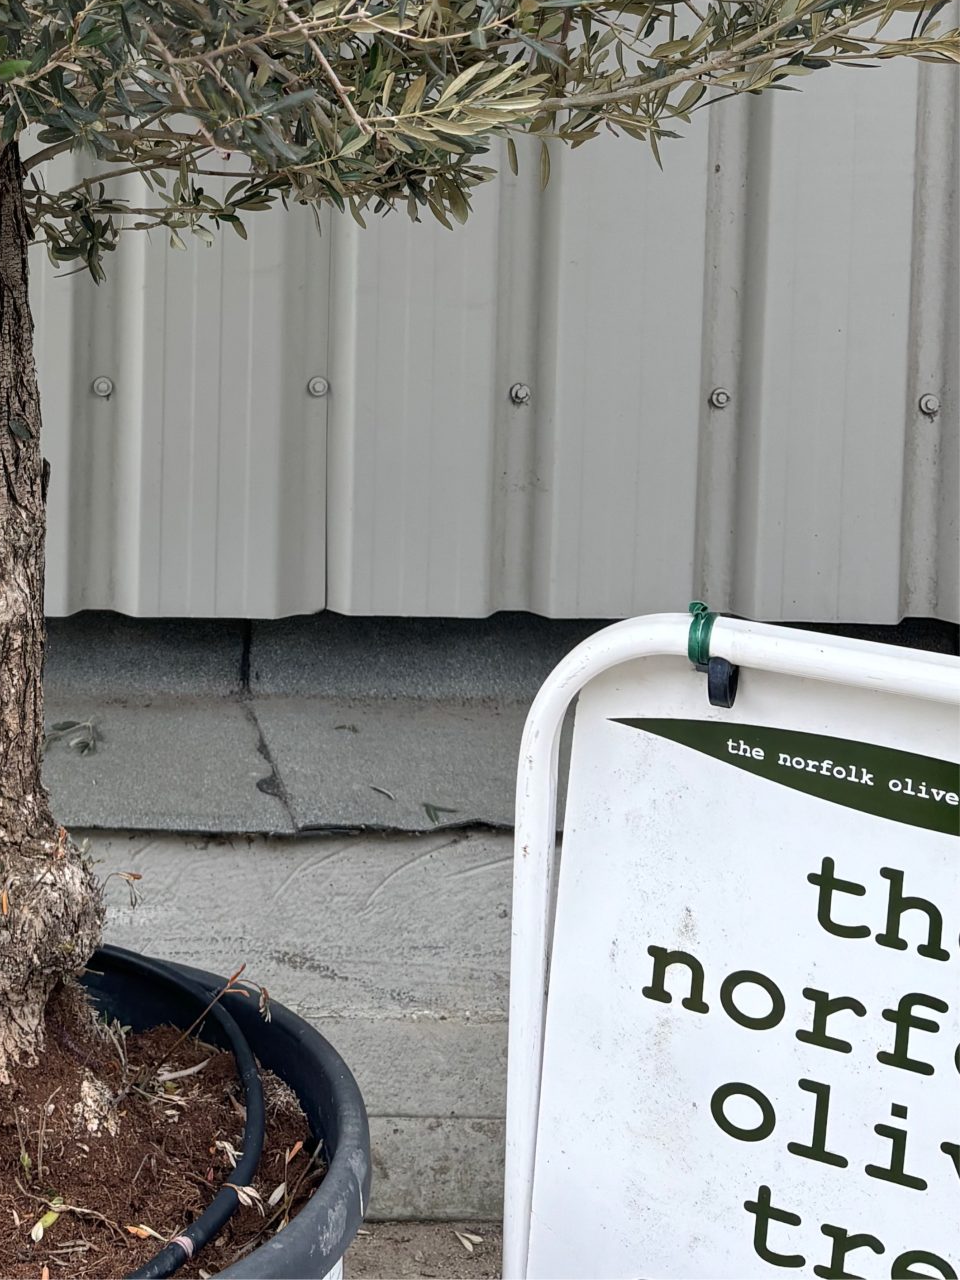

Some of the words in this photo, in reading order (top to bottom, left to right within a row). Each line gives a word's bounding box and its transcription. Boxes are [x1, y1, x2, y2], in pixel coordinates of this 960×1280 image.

[726, 738, 765, 761] the
[777, 752, 874, 786] norfolk
[888, 778, 960, 806] olive
[806, 857, 960, 962] th
[642, 945, 960, 1076] norf
